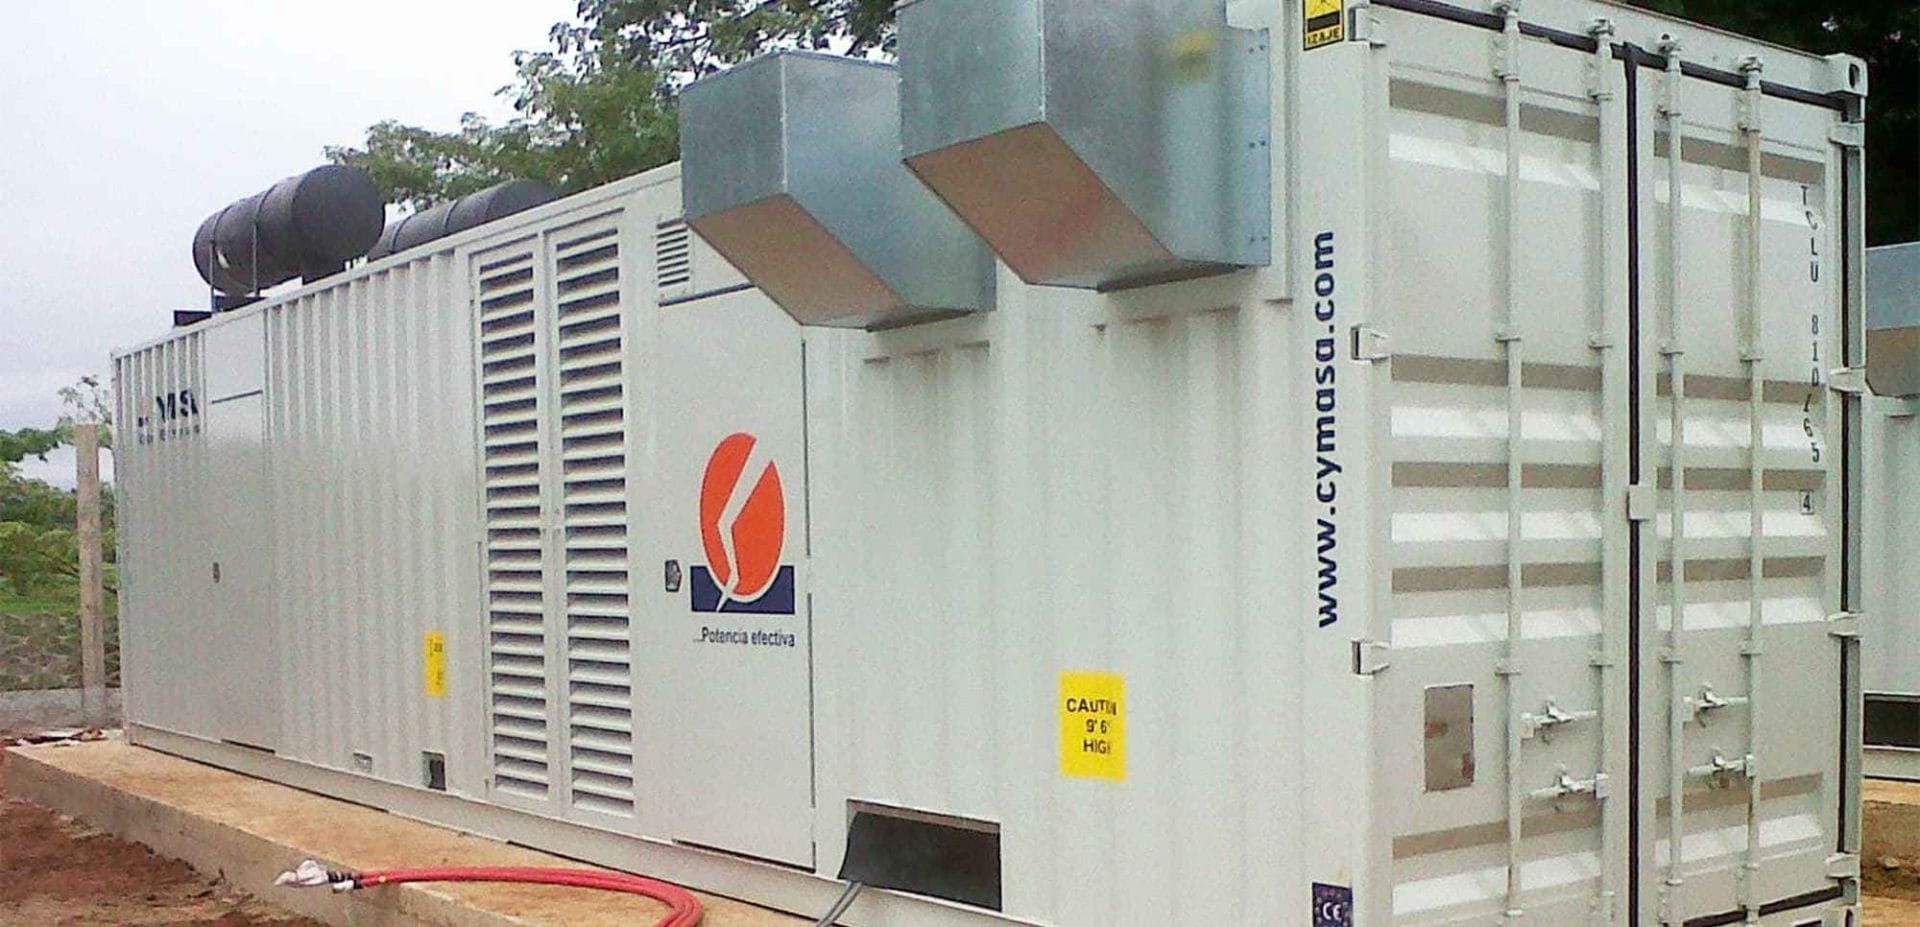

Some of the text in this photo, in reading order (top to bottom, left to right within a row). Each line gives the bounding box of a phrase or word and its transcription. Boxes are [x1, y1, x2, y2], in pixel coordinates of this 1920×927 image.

[1307, 27, 1341, 45] IZAJE
[1801, 184, 1819, 283] TCLU
[1314, 231, 1342, 628] www.cymasa.com
[751, 629, 796, 648] efectiva
[1322, 902, 1342, 921] CE
